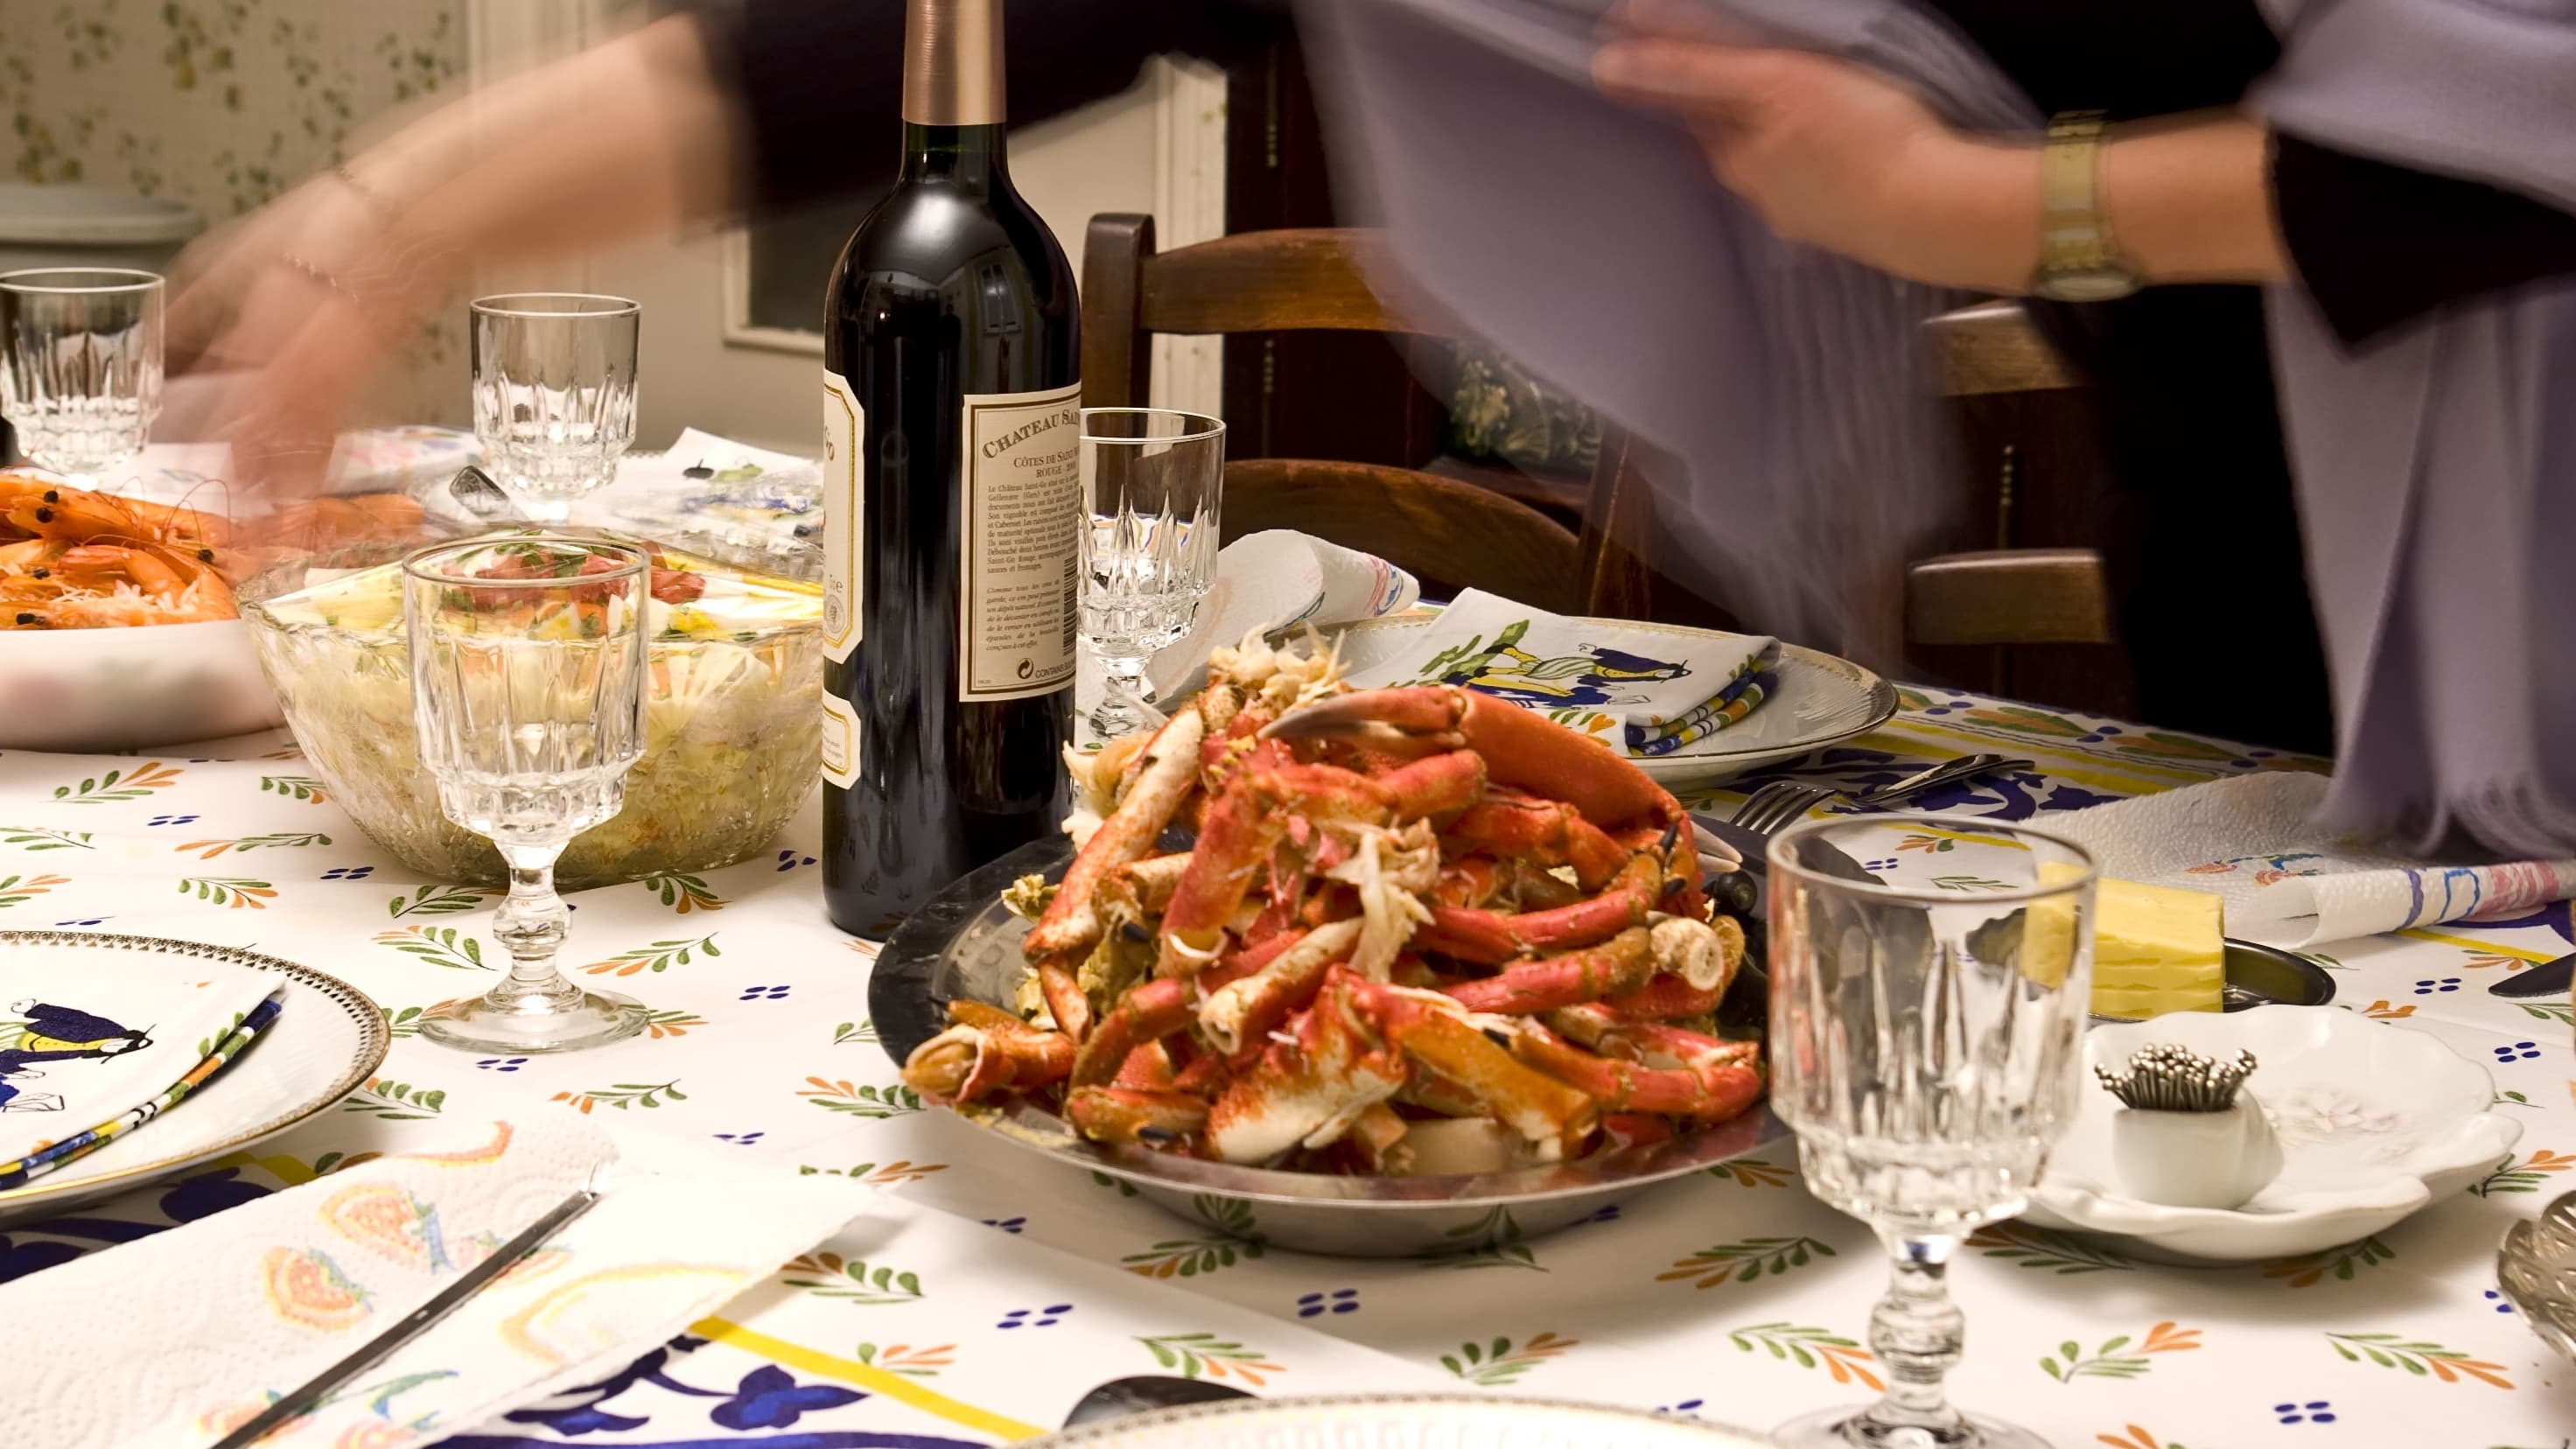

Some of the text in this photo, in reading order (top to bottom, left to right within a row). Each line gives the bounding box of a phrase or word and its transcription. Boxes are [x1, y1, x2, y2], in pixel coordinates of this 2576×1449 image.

[983, 410, 1080, 458] CHATEAU SAIN
[1014, 455, 1044, 468] CÔTES
[1046, 454, 1056, 465] DE
[1036, 466, 1062, 478] ROUGE
